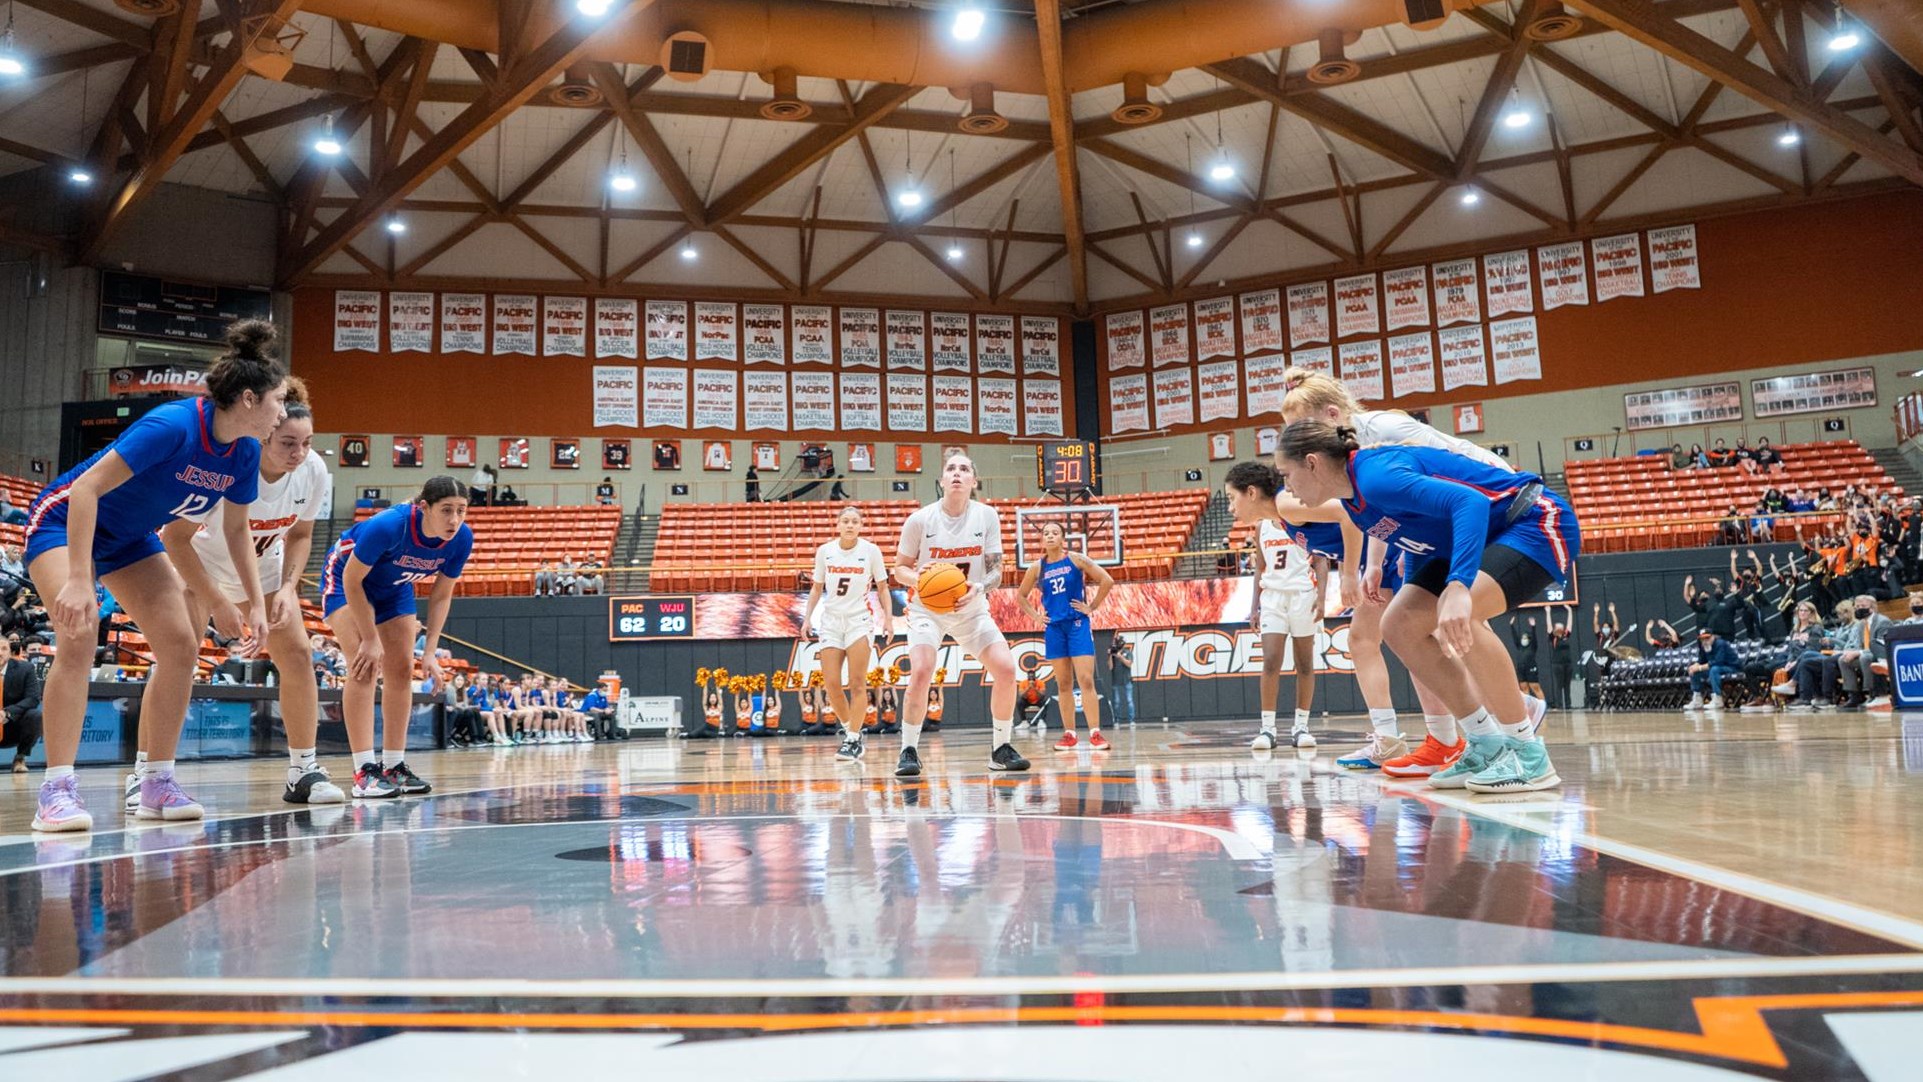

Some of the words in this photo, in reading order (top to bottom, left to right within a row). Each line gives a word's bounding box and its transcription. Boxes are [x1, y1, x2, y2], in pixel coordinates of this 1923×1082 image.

[1653, 240, 1692, 253] PACIFIC
[1596, 250, 1637, 262] PACIFIC
[1436, 264, 1472, 274] UNIVERSITY
[1290, 287, 1324, 296] UNIVERSITY
[339, 305, 377, 313] PACIFIC
[445, 307, 482, 315] PACIFIC
[1198, 302, 1229, 311] UNIVERSITY
[497, 308, 532, 317] PACIFIC
[547, 311, 583, 320] PACIFIC
[599, 312, 634, 321] PACIFIC
[698, 315, 733, 324] PACIFIC
[795, 319, 828, 328] PACIFIC
[746, 320, 781, 329] PACIFIC
[842, 324, 877, 332] PACIFIC
[614, 329, 633, 337] WEST
[888, 326, 922, 335] PACIFIC
[934, 328, 967, 336] PACIFIC
[978, 330, 1011, 339] PACIFIC
[1023, 332, 1056, 341] PACIFIC
[1495, 332, 1533, 344] PACIFIC
[1443, 340, 1480, 352] PACIFIC
[1393, 347, 1428, 359] PACIFIC
[1248, 368, 1282, 379] PACIFIC
[648, 382, 682, 390] PACIFIC
[698, 384, 732, 392] PACIFIC
[748, 385, 782, 393] PACIFIC
[796, 386, 829, 394] PACIFIC
[890, 387, 922, 396] PACIFIC
[936, 389, 968, 397] PACIFIC
[981, 391, 1013, 400] PACIFIC
[1027, 392, 1058, 400] PACIFIC
[1830, 420, 1839, 430] Q
[346, 442, 363, 454] 40
[1580, 440, 1588, 450] Q
[610, 450, 622, 460] 39
[1056, 444, 1082, 457] 4:08
[1054, 460, 1080, 484] 30
[175, 464, 235, 492] JESSUP
[897, 482, 904, 490] N
[168, 493, 209, 517] 12
[928, 545, 982, 559] TIGERS
[1274, 550, 1288, 570] 3
[827, 566, 864, 574] TIGERS
[837, 578, 850, 596] 5
[1050, 576, 1066, 595] 32
[1547, 590, 1564, 600] 30
[621, 604, 644, 614] PAC
[660, 602, 685, 612] WJU
[620, 616, 646, 632] 62
[660, 616, 686, 632] 20
[1900, 664, 1923, 682] BAN
[80, 730, 114, 743] RITORY
